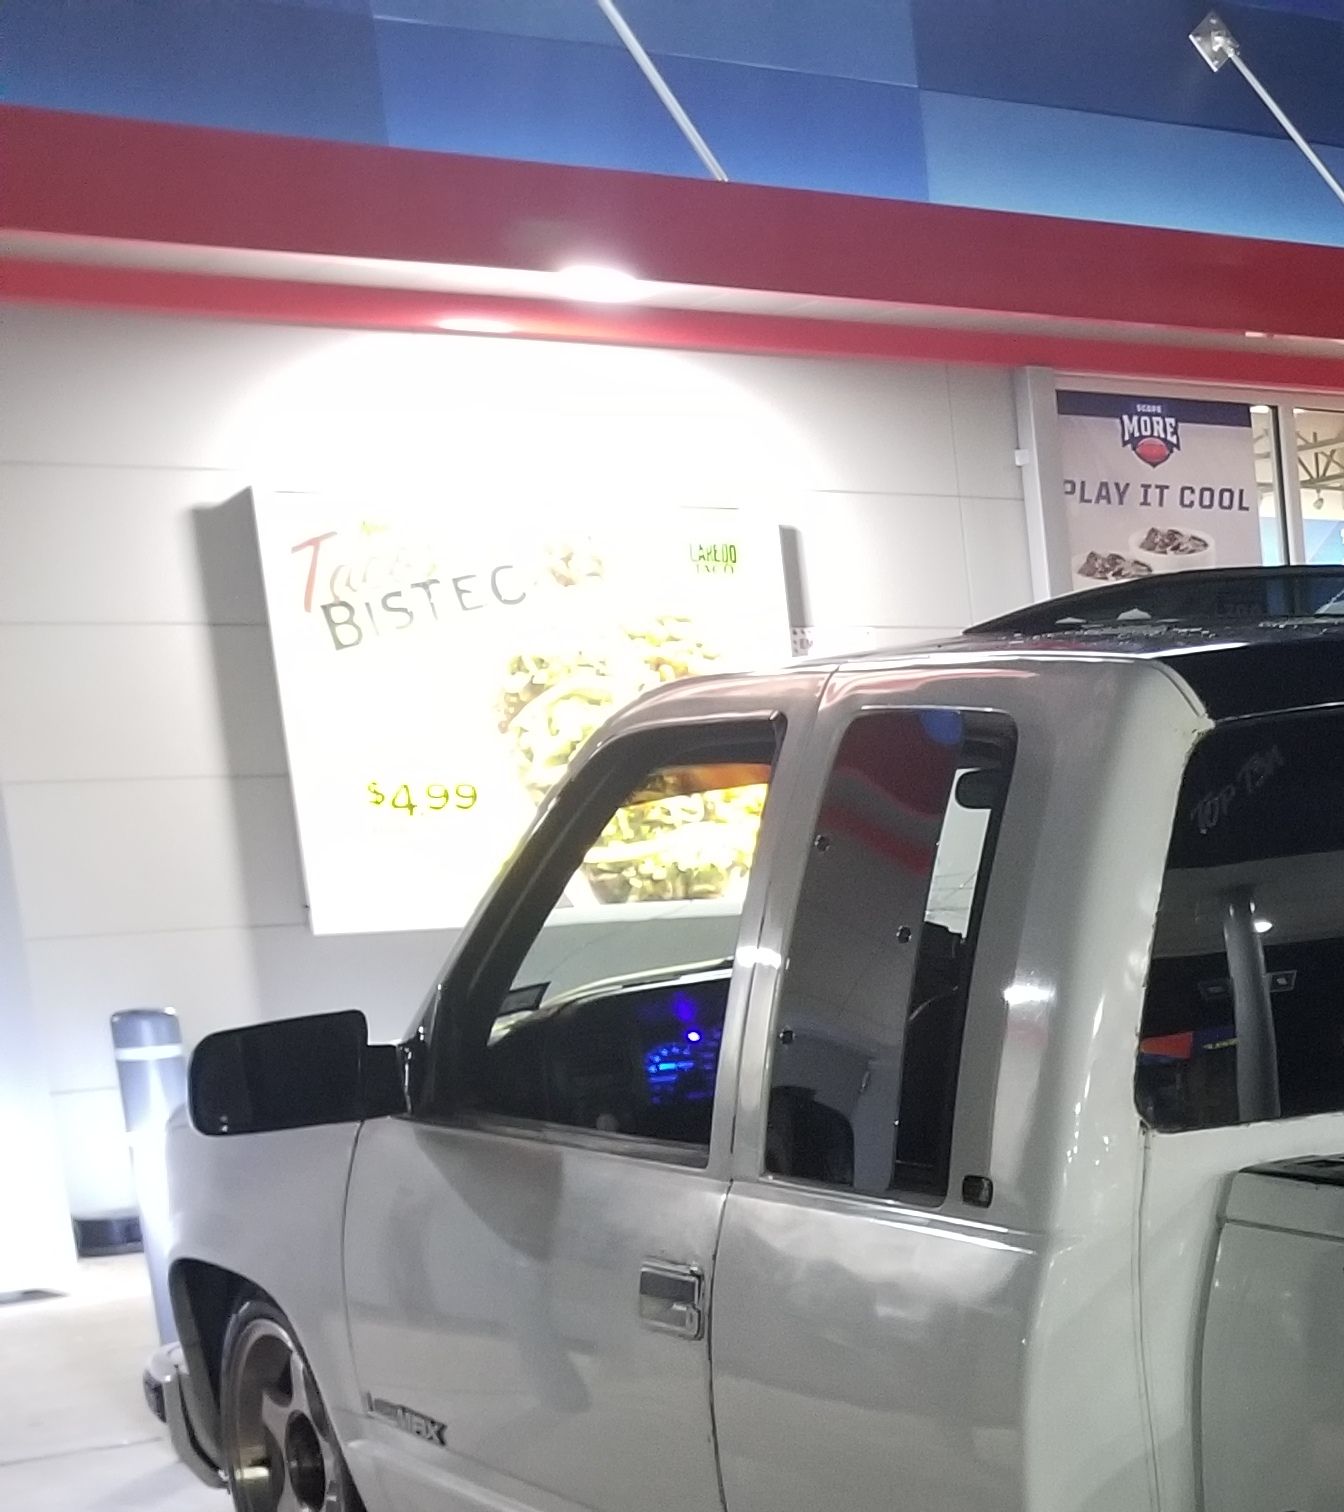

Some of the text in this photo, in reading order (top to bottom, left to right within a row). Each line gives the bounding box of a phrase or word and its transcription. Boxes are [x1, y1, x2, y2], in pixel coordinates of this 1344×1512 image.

[1122, 414, 1177, 445] MORE
[1063, 479, 1250, 511] PLAY IT COOL
[320, 565, 526, 651] BISTEC
